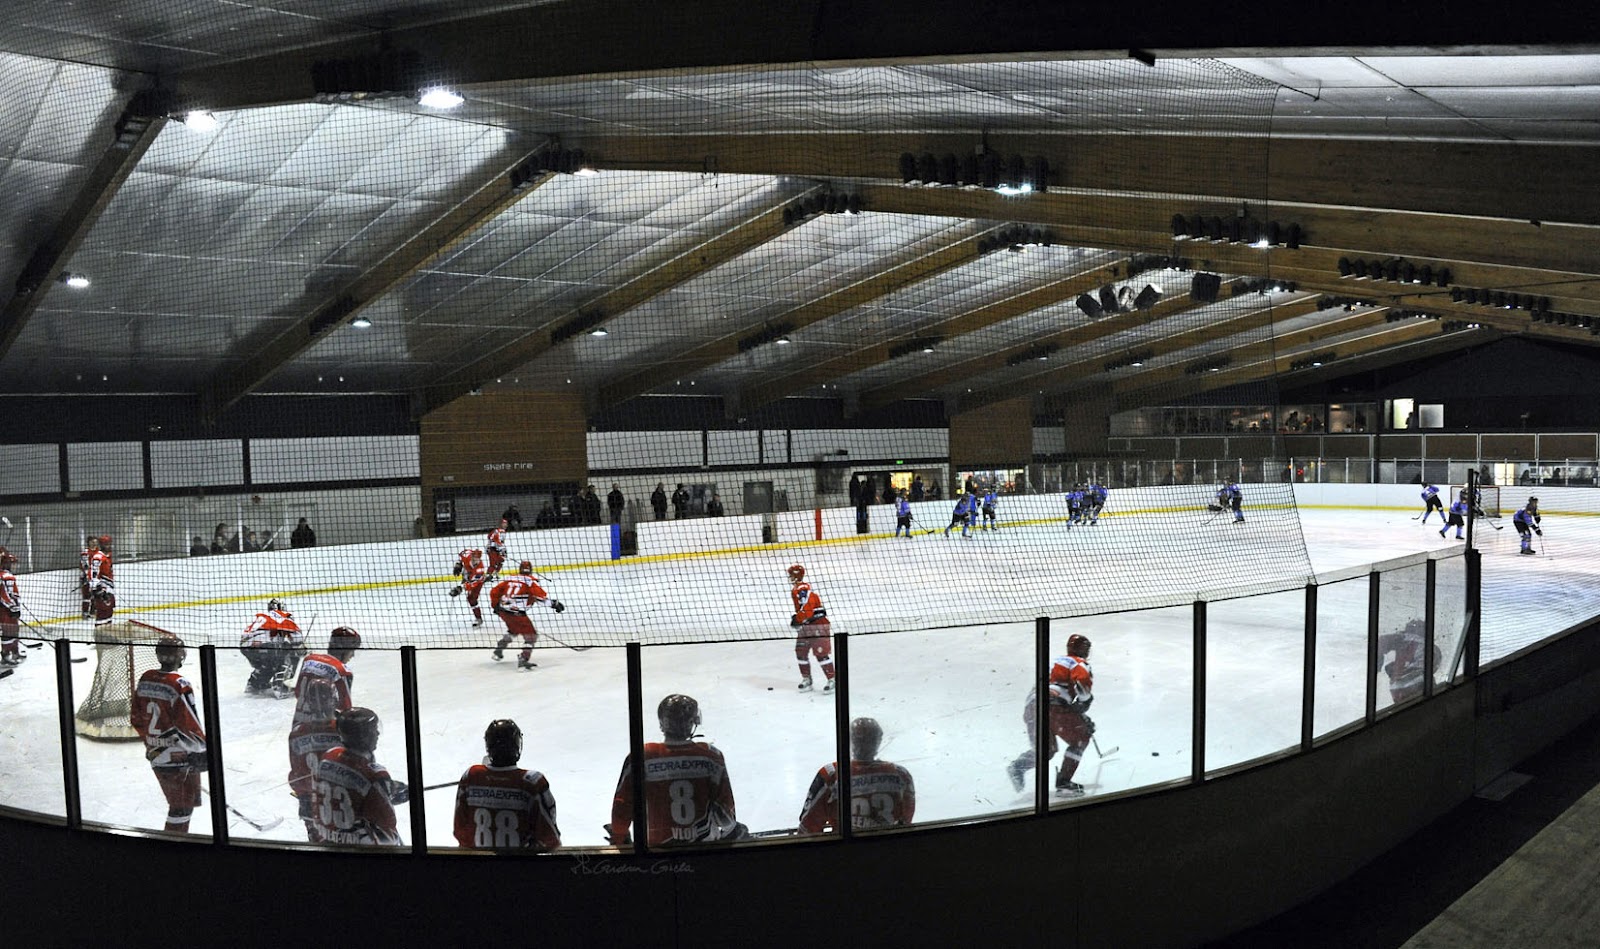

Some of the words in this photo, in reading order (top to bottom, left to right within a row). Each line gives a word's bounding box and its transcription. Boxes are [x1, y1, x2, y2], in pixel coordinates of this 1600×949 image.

[146, 701, 162, 735] 2
[312, 780, 355, 830] 33
[669, 780, 695, 826] 8
[473, 807, 521, 848] 88
